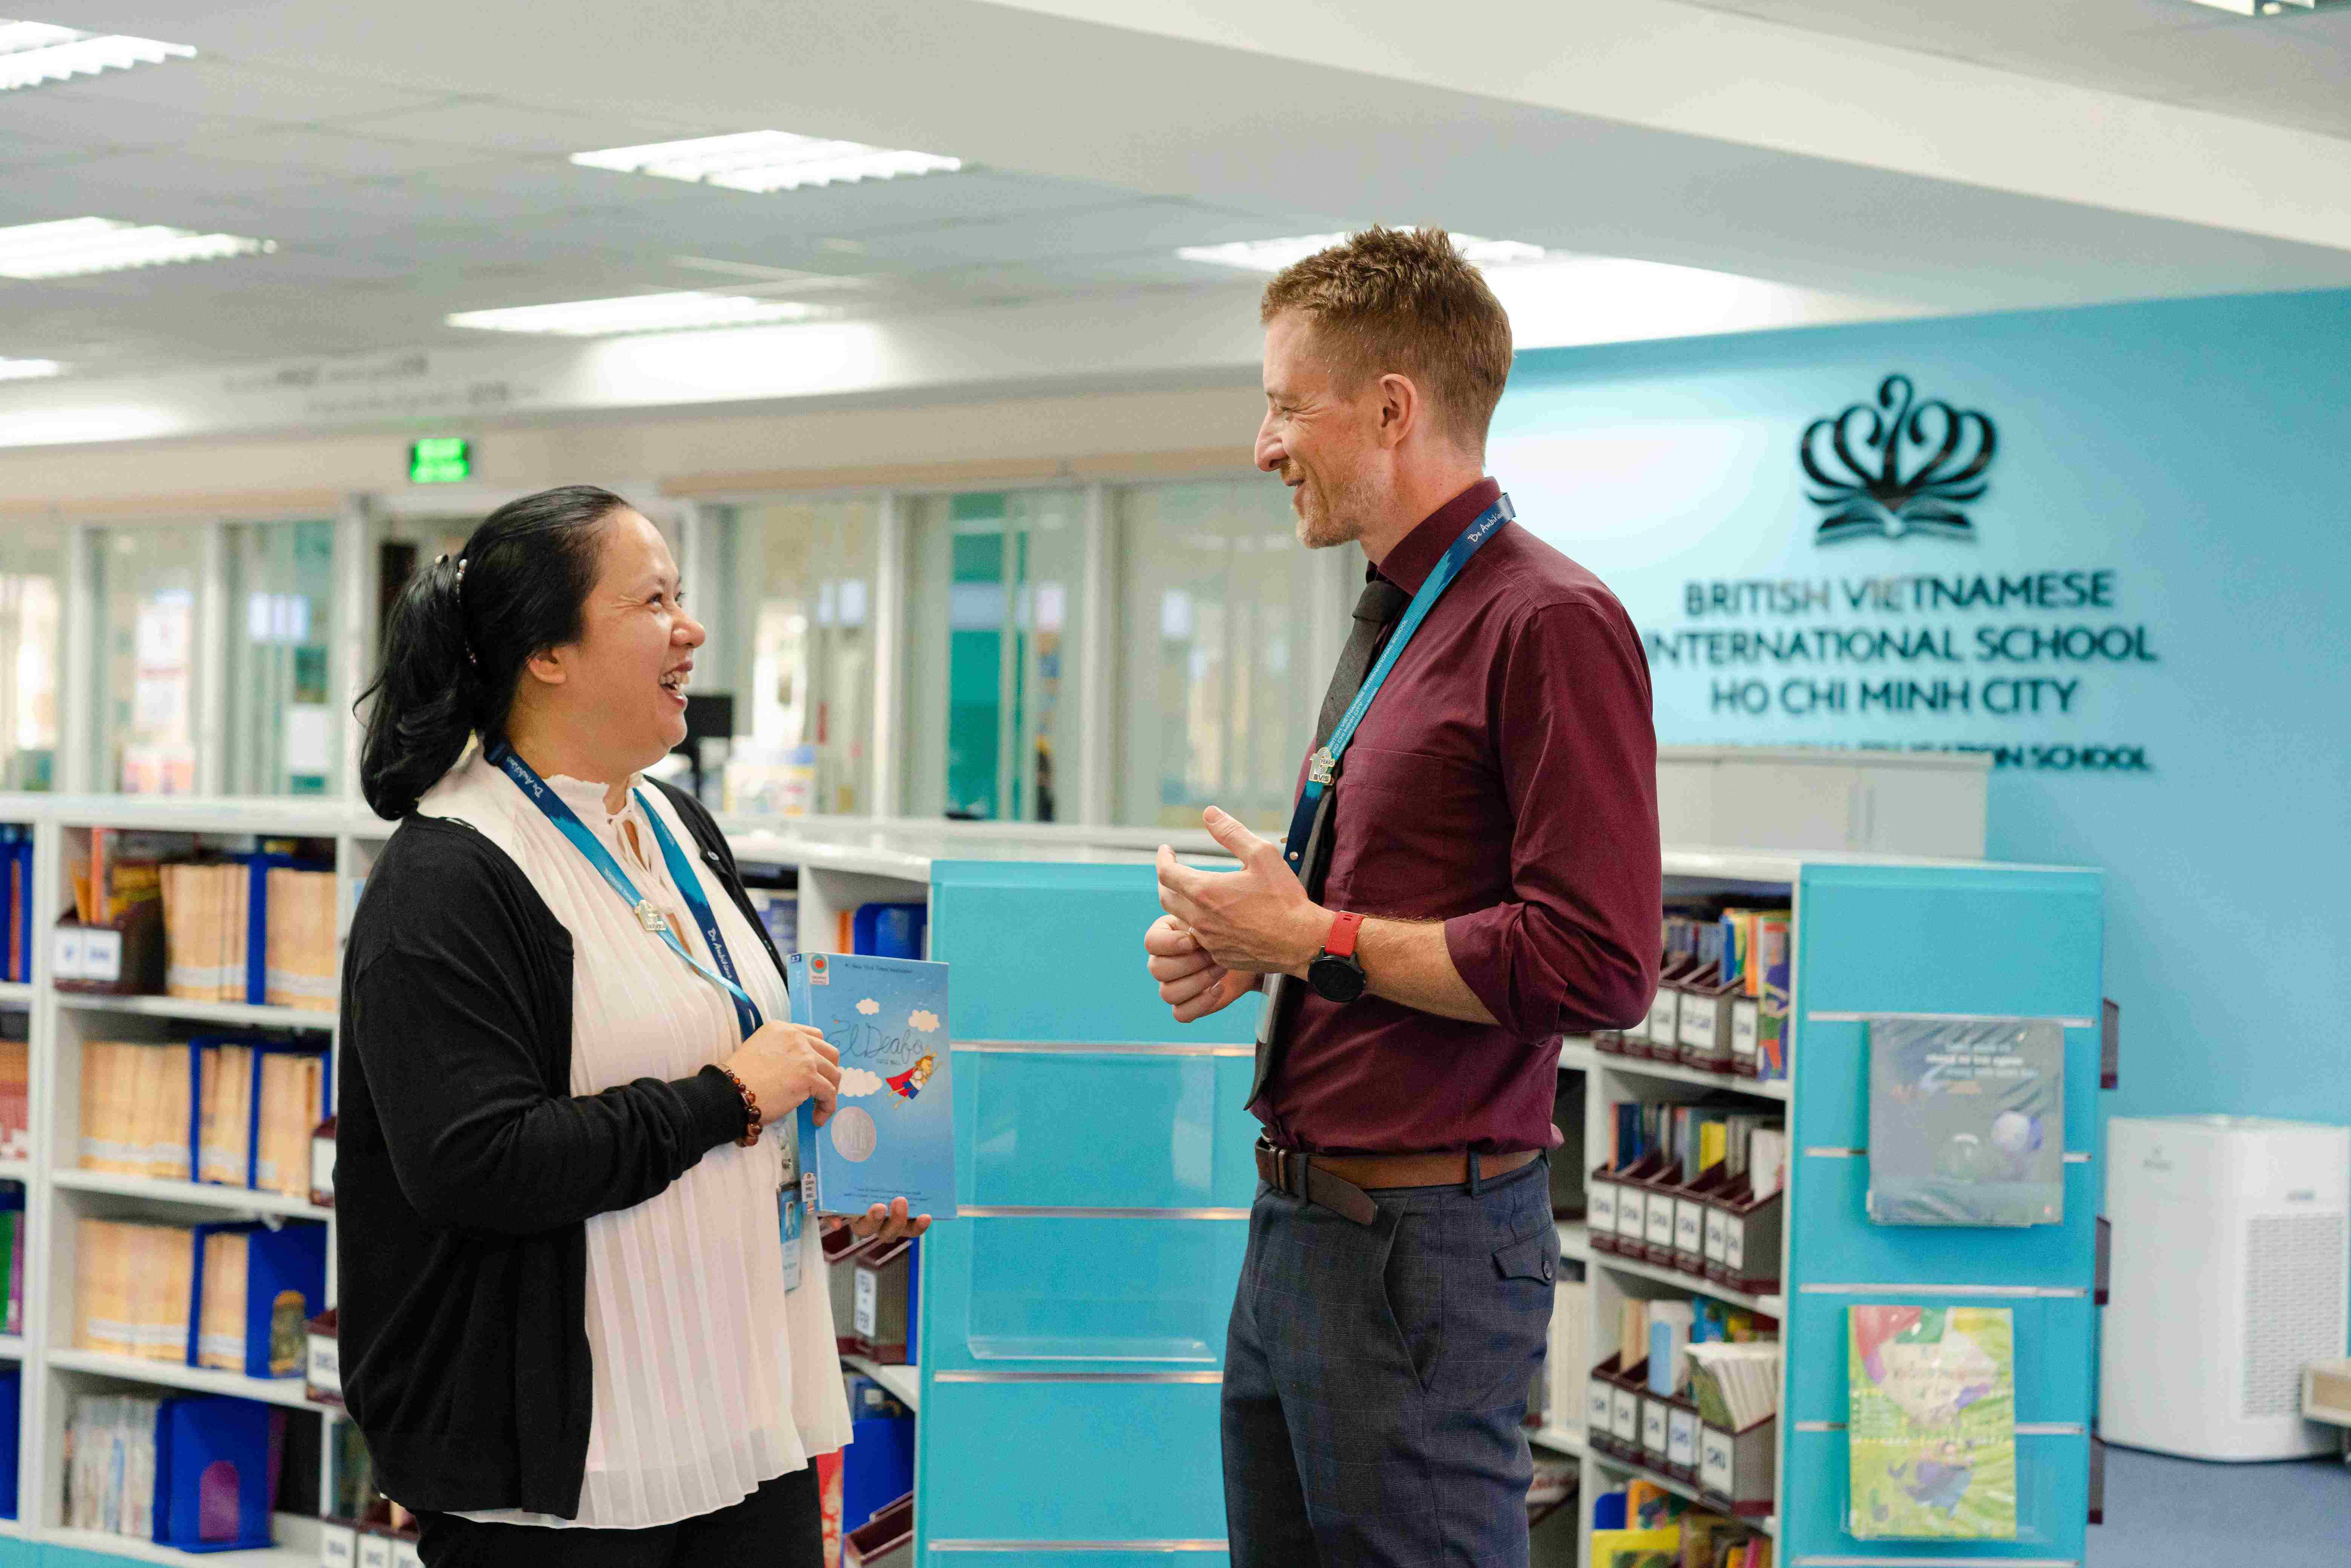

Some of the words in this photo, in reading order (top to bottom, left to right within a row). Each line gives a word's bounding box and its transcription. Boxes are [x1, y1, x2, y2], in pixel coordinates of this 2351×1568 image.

[1467, 531, 1482, 542] Be
[1685, 581, 1830, 616] BRITISH
[1841, 570, 2115, 612] VIETNAMESE
[1976, 625, 2158, 663] SCHOOL
[1711, 680, 1769, 714] HO
[1780, 679, 1846, 714] CHI
[1860, 679, 1970, 714] MINH
[1981, 678, 2080, 714] CITY
[863, 1022, 923, 1064] Deafo
